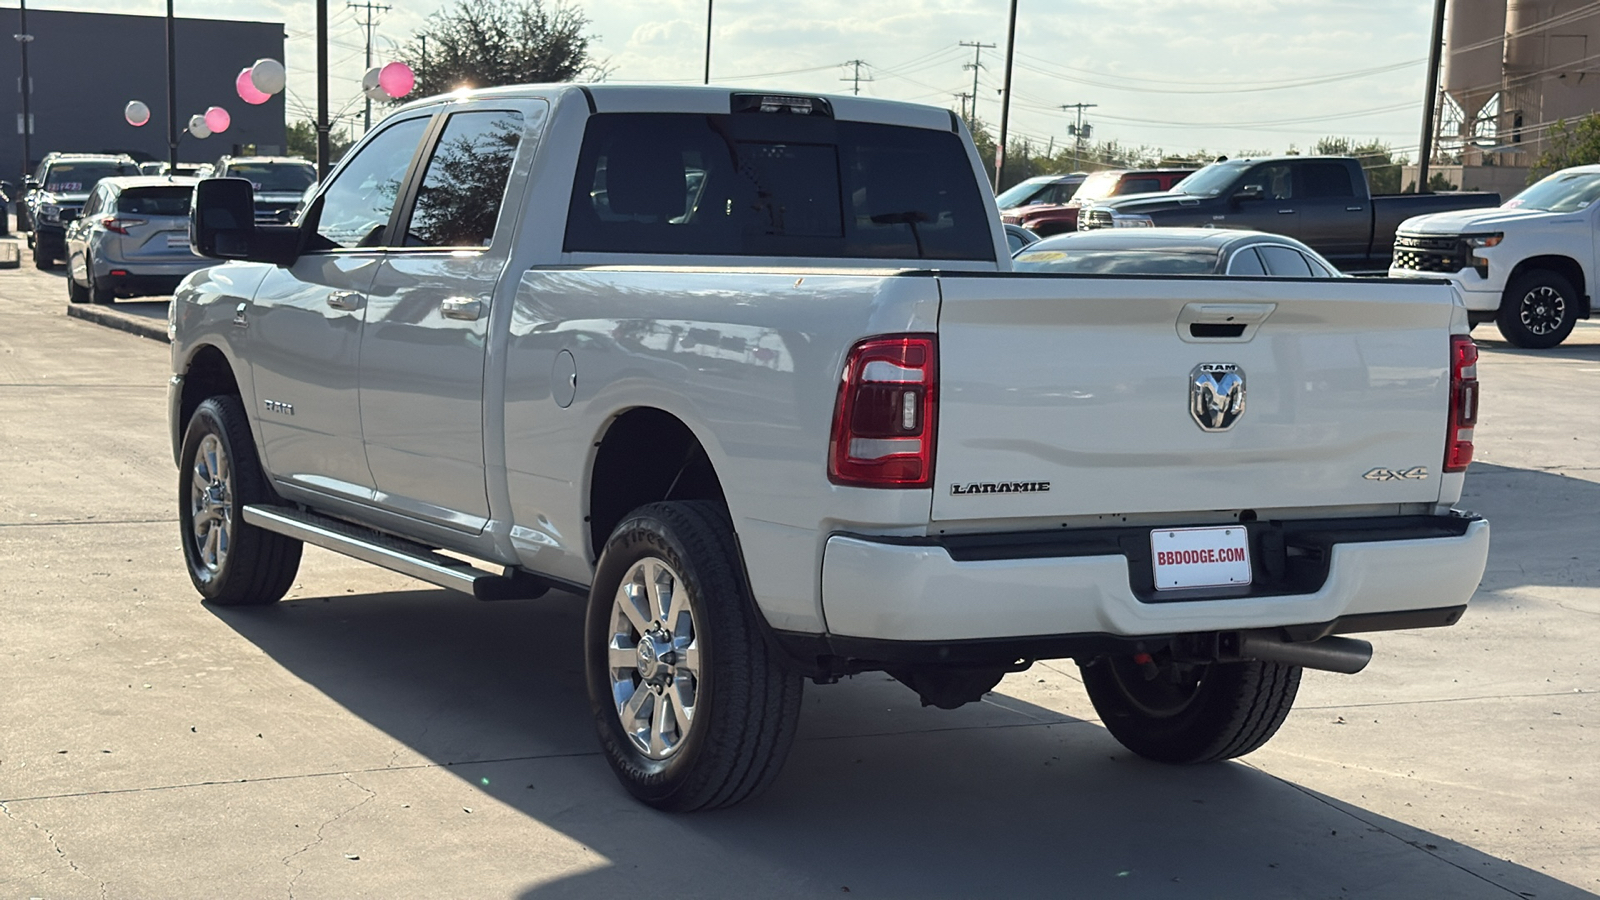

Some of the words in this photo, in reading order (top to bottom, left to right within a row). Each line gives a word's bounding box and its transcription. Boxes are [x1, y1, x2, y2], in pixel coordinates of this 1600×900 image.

[1202, 363, 1236, 371] RAM
[264, 399, 295, 416] RAM
[951, 481, 1050, 496] LARAMIE
[1157, 547, 1246, 566] BBDODGE.COM
